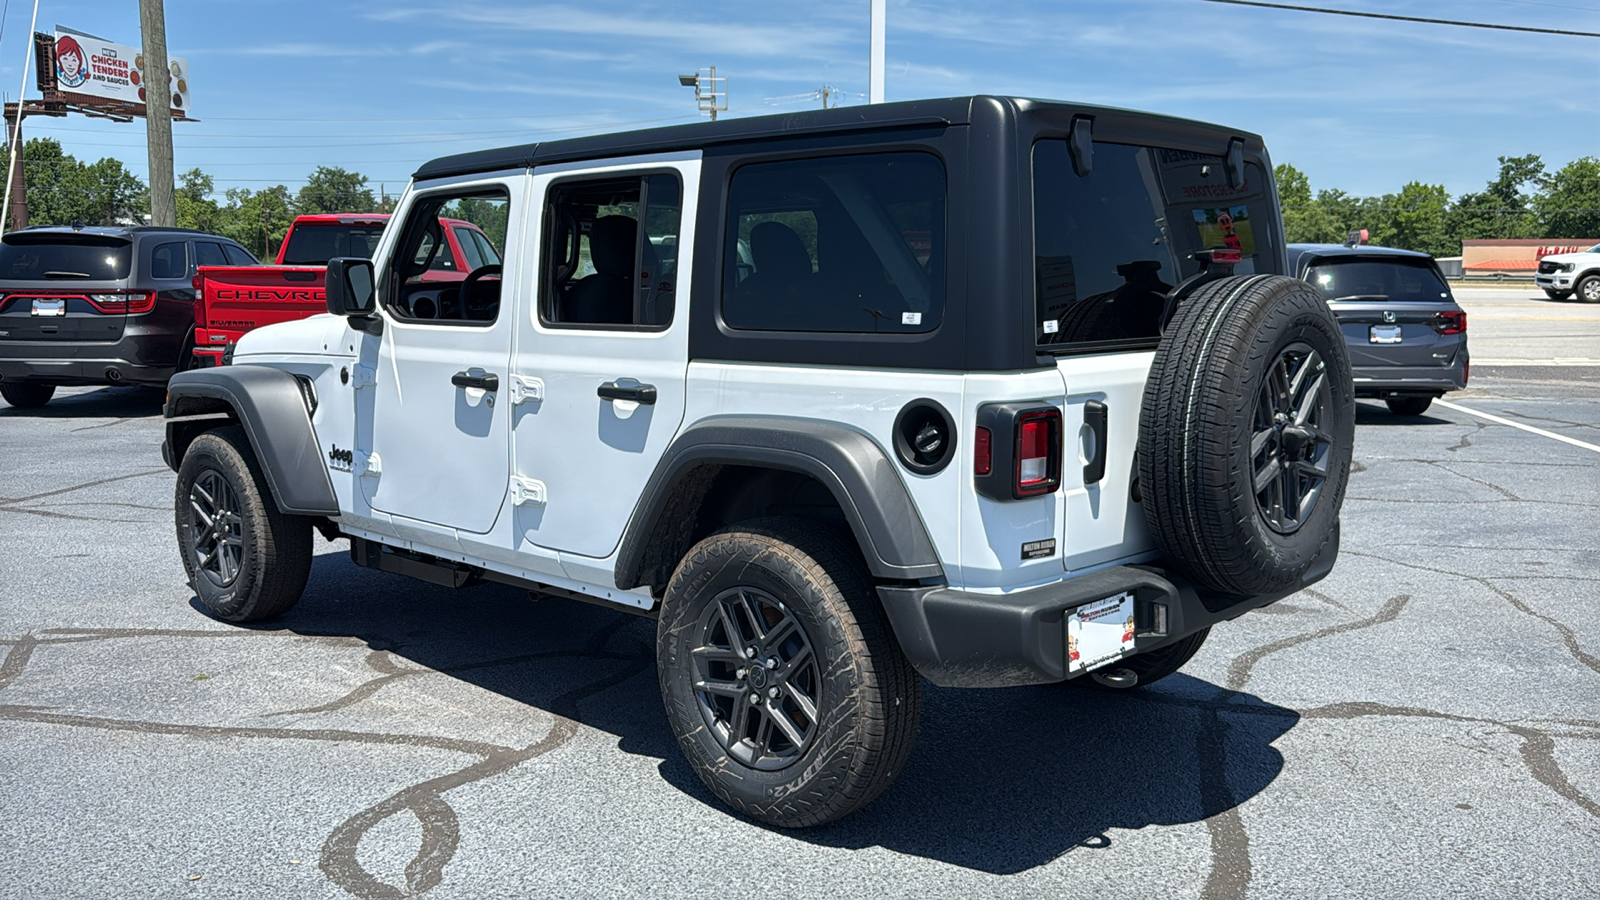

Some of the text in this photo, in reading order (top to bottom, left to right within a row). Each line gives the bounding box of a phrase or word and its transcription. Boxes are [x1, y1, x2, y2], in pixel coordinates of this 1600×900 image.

[103, 49, 117, 58] NEW
[91, 54, 128, 69] CHICKEN
[92, 64, 129, 78] TENDERS
[93, 74, 129, 86] AND SAUCES
[329, 443, 353, 466] Jeep
[1100, 603, 1120, 613] RUBEN
